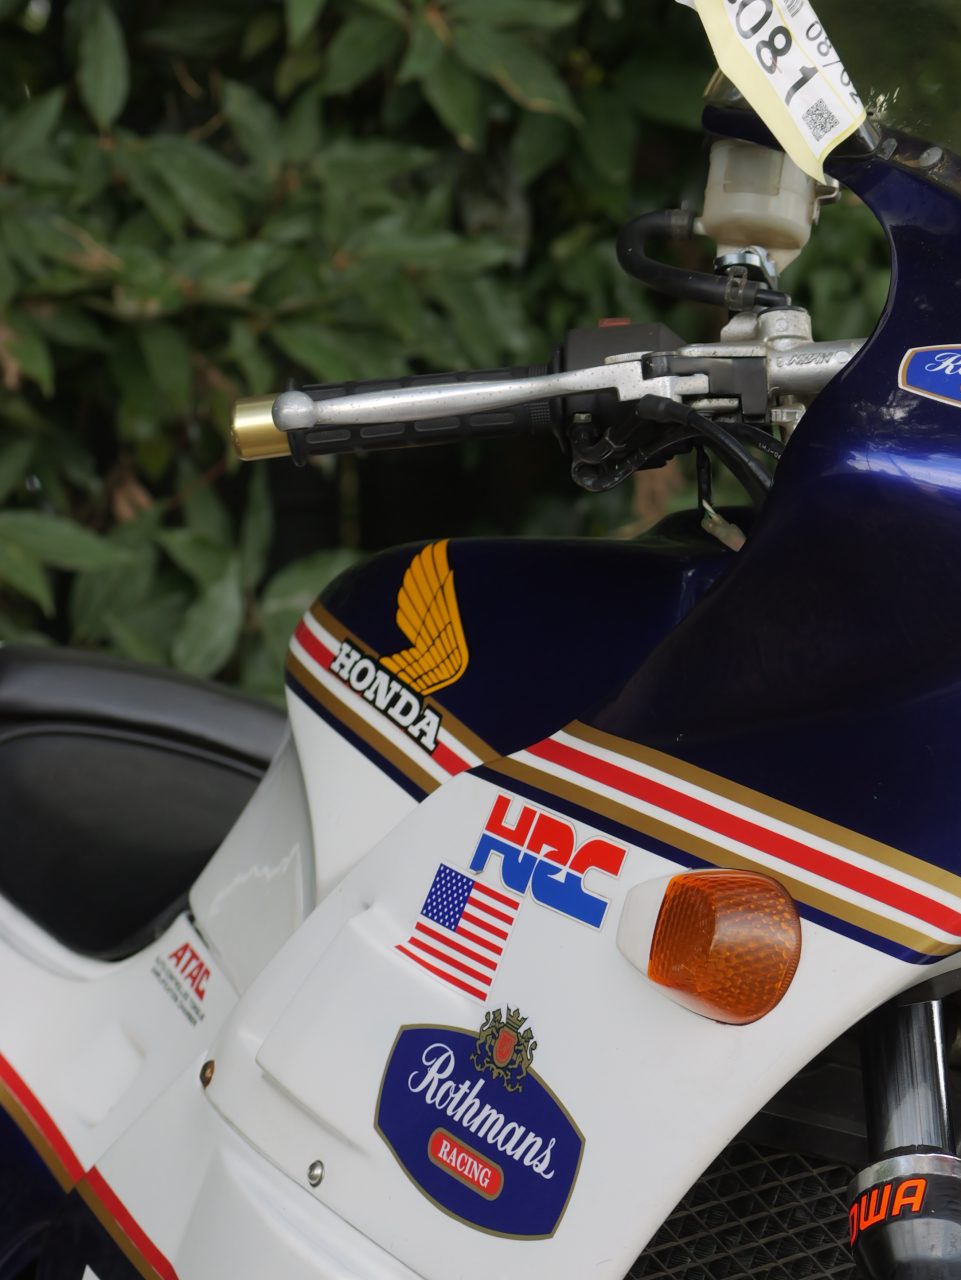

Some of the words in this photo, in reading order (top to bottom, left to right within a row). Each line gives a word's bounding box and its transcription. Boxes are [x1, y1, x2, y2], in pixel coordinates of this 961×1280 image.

[727, 0, 819, 106] 081
[329, 641, 442, 752] HONDA
[469, 794, 627, 929] HRC
[168, 942, 210, 1001] ATAC
[408, 1043, 556, 1179] Rothmans
[438, 1139, 491, 1188] RACING
